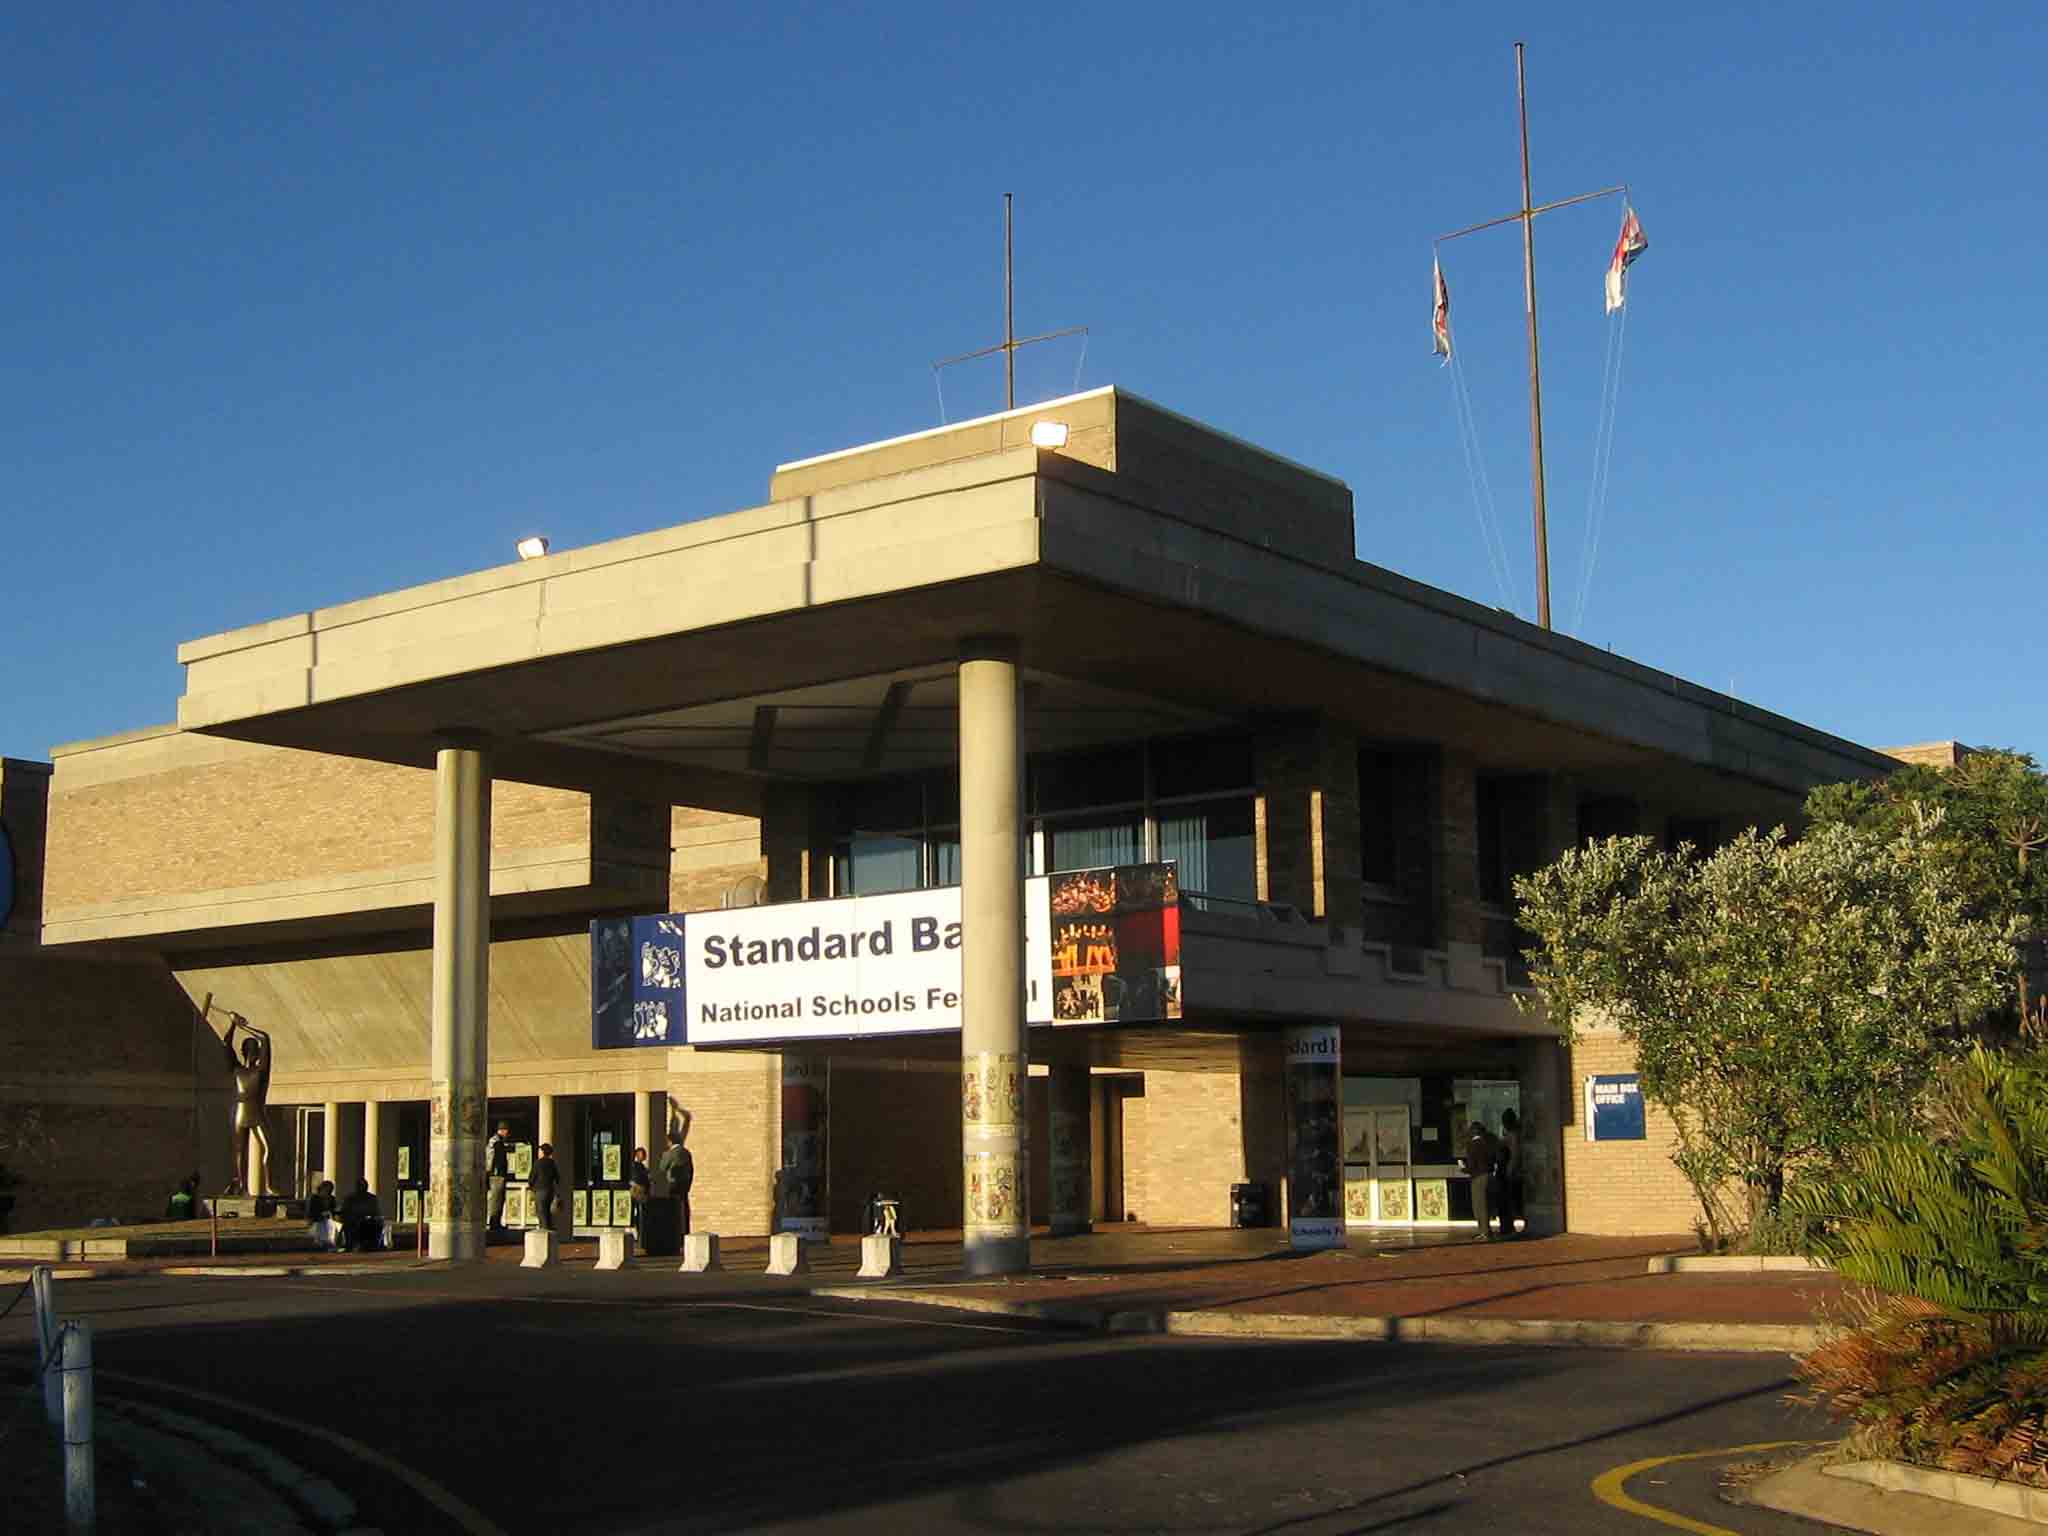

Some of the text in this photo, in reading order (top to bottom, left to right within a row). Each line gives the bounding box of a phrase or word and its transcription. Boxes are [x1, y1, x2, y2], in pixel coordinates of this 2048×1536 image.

[704, 920, 893, 969] Standard
[701, 997, 802, 1024] National
[812, 990, 917, 1017] Schools
[1595, 1083, 1639, 1094] MAIN BOX
[1595, 1094, 1625, 1105] OFFICE
